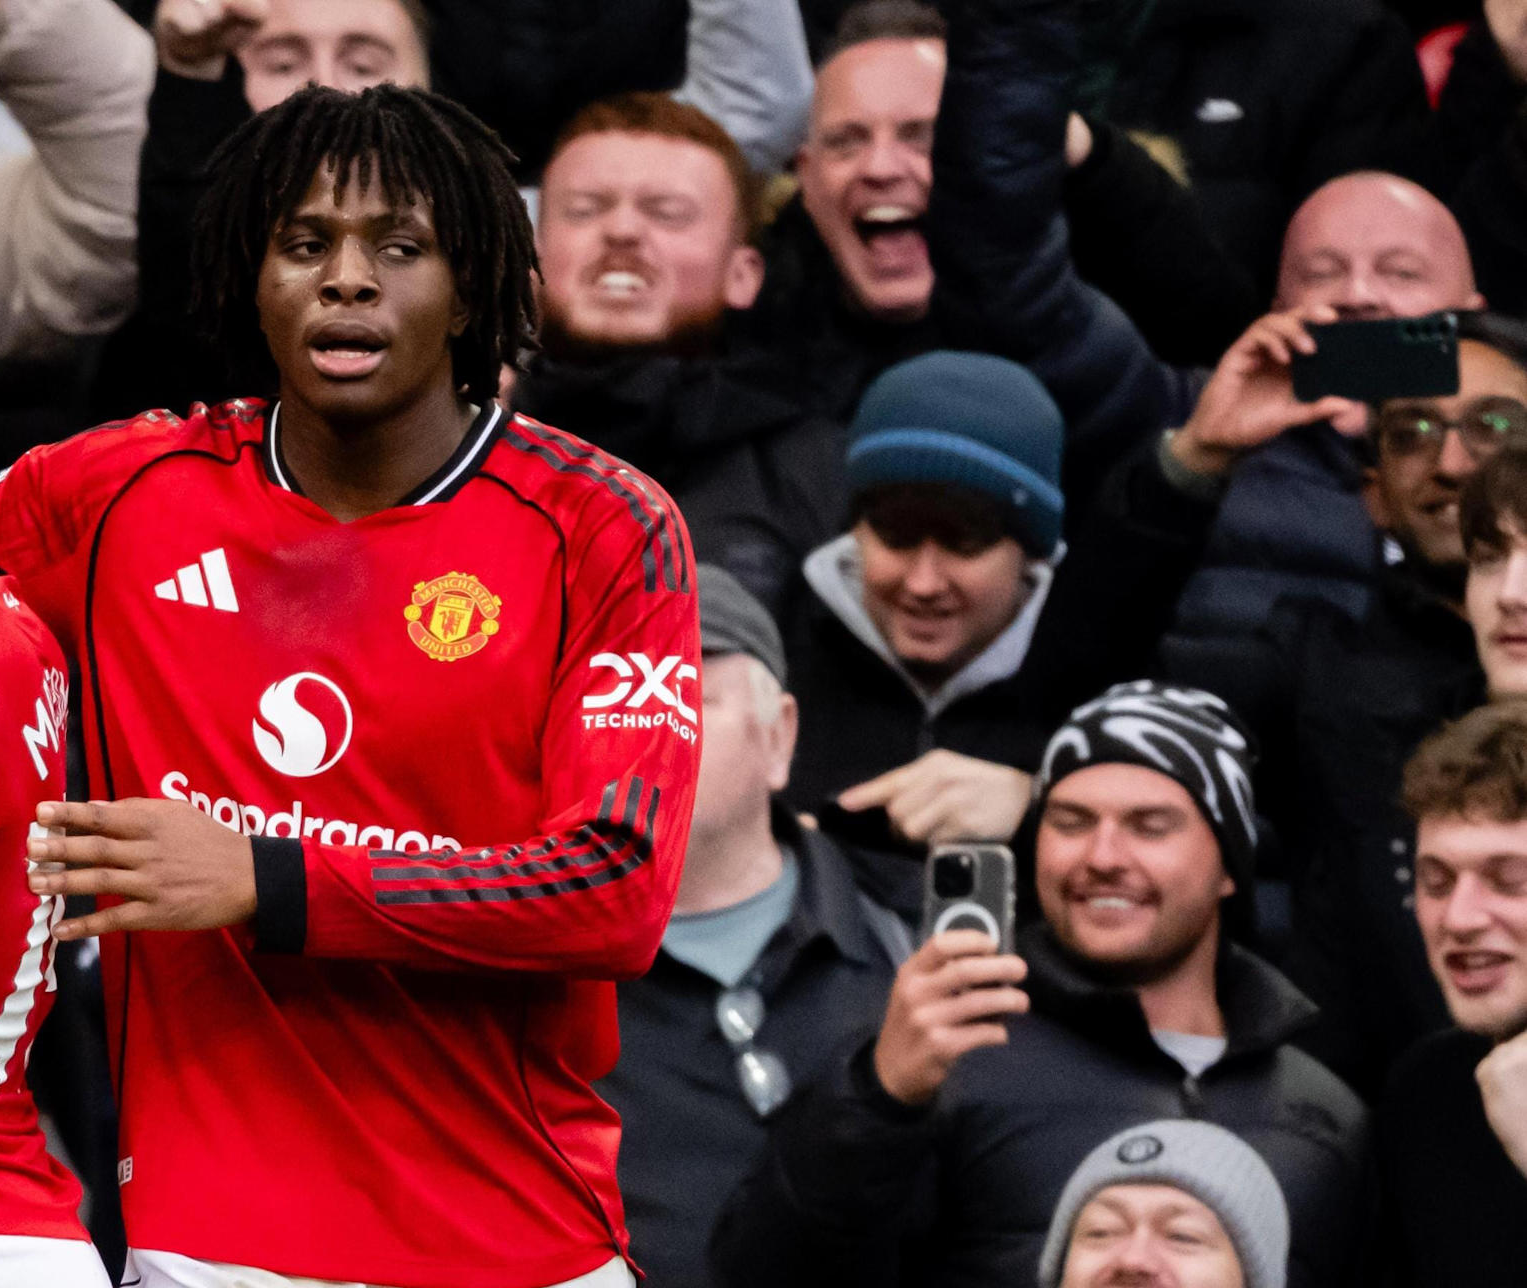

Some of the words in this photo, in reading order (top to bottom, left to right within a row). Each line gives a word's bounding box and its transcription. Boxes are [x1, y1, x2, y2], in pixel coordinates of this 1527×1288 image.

[419, 579, 495, 613] MANCHESTER
[420, 636, 472, 655] UNITED
[581, 711, 697, 745] TECHNOLOGY
